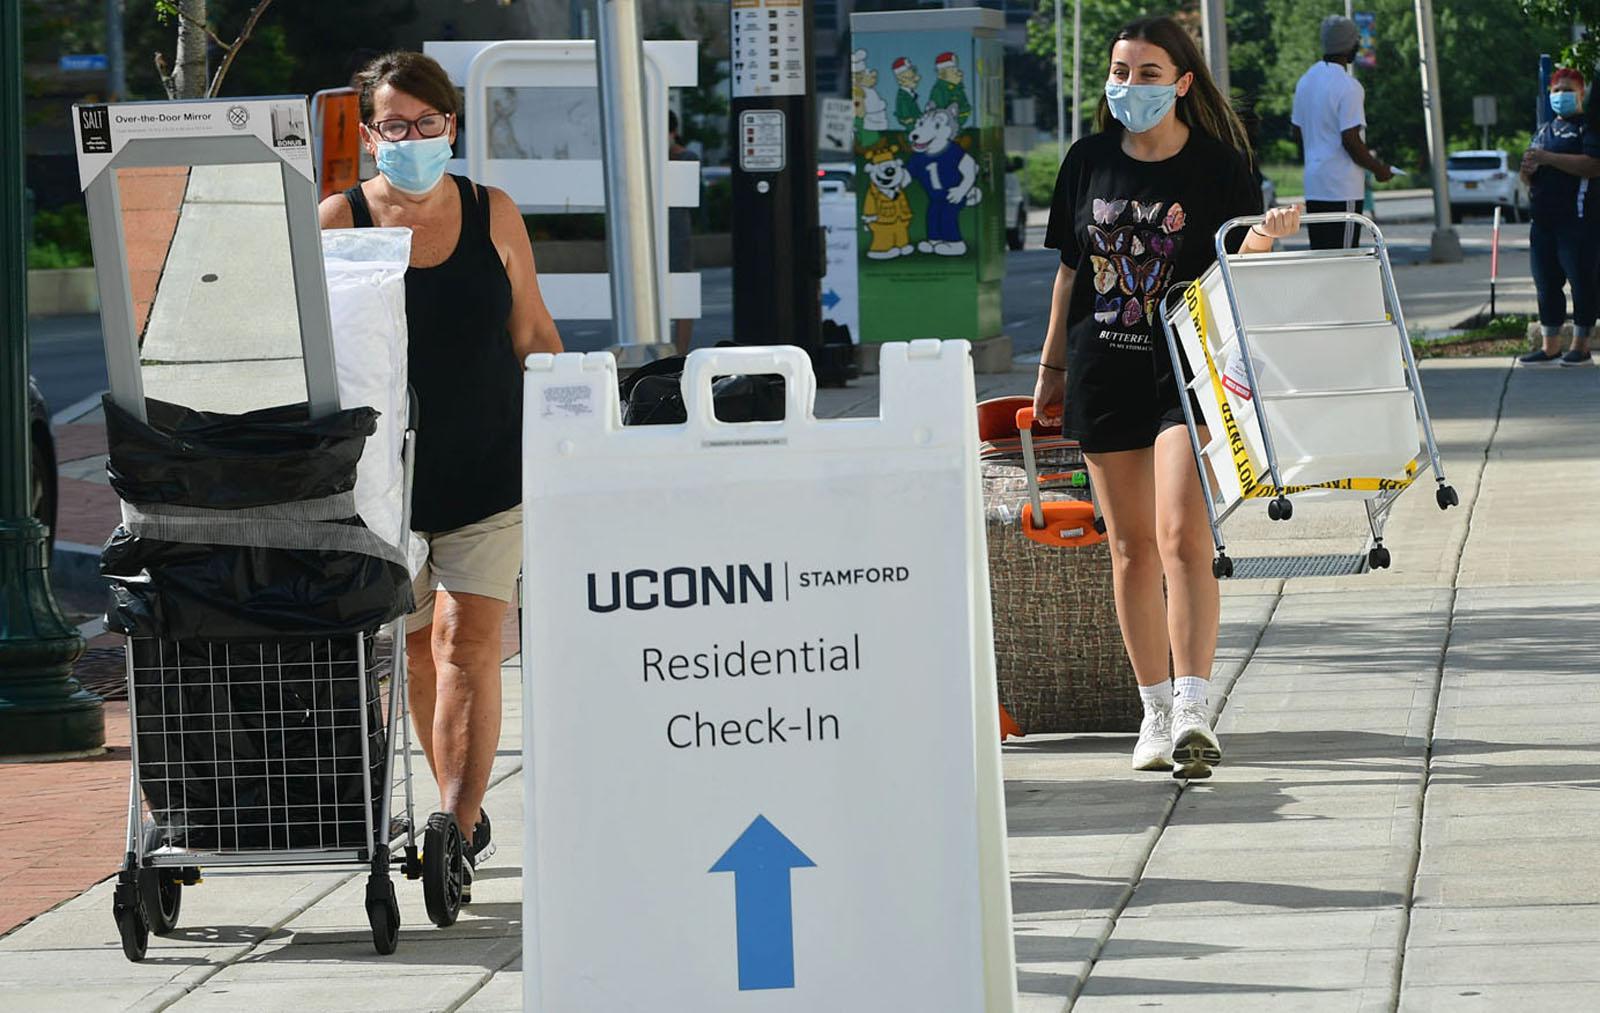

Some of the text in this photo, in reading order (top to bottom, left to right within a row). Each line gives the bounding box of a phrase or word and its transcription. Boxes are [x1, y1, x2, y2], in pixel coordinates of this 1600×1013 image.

[82, 110, 104, 129] SALT
[115, 112, 212, 124] Over-the-Door Mirror
[925, 162, 942, 190] 1
[1099, 330, 1152, 344] BUTTERFL
[1236, 458, 1257, 497] NOT
[587, 562, 909, 614] UCONN STAMFORD
[643, 633, 860, 682] Residential
[667, 706, 840, 749] Check-In
